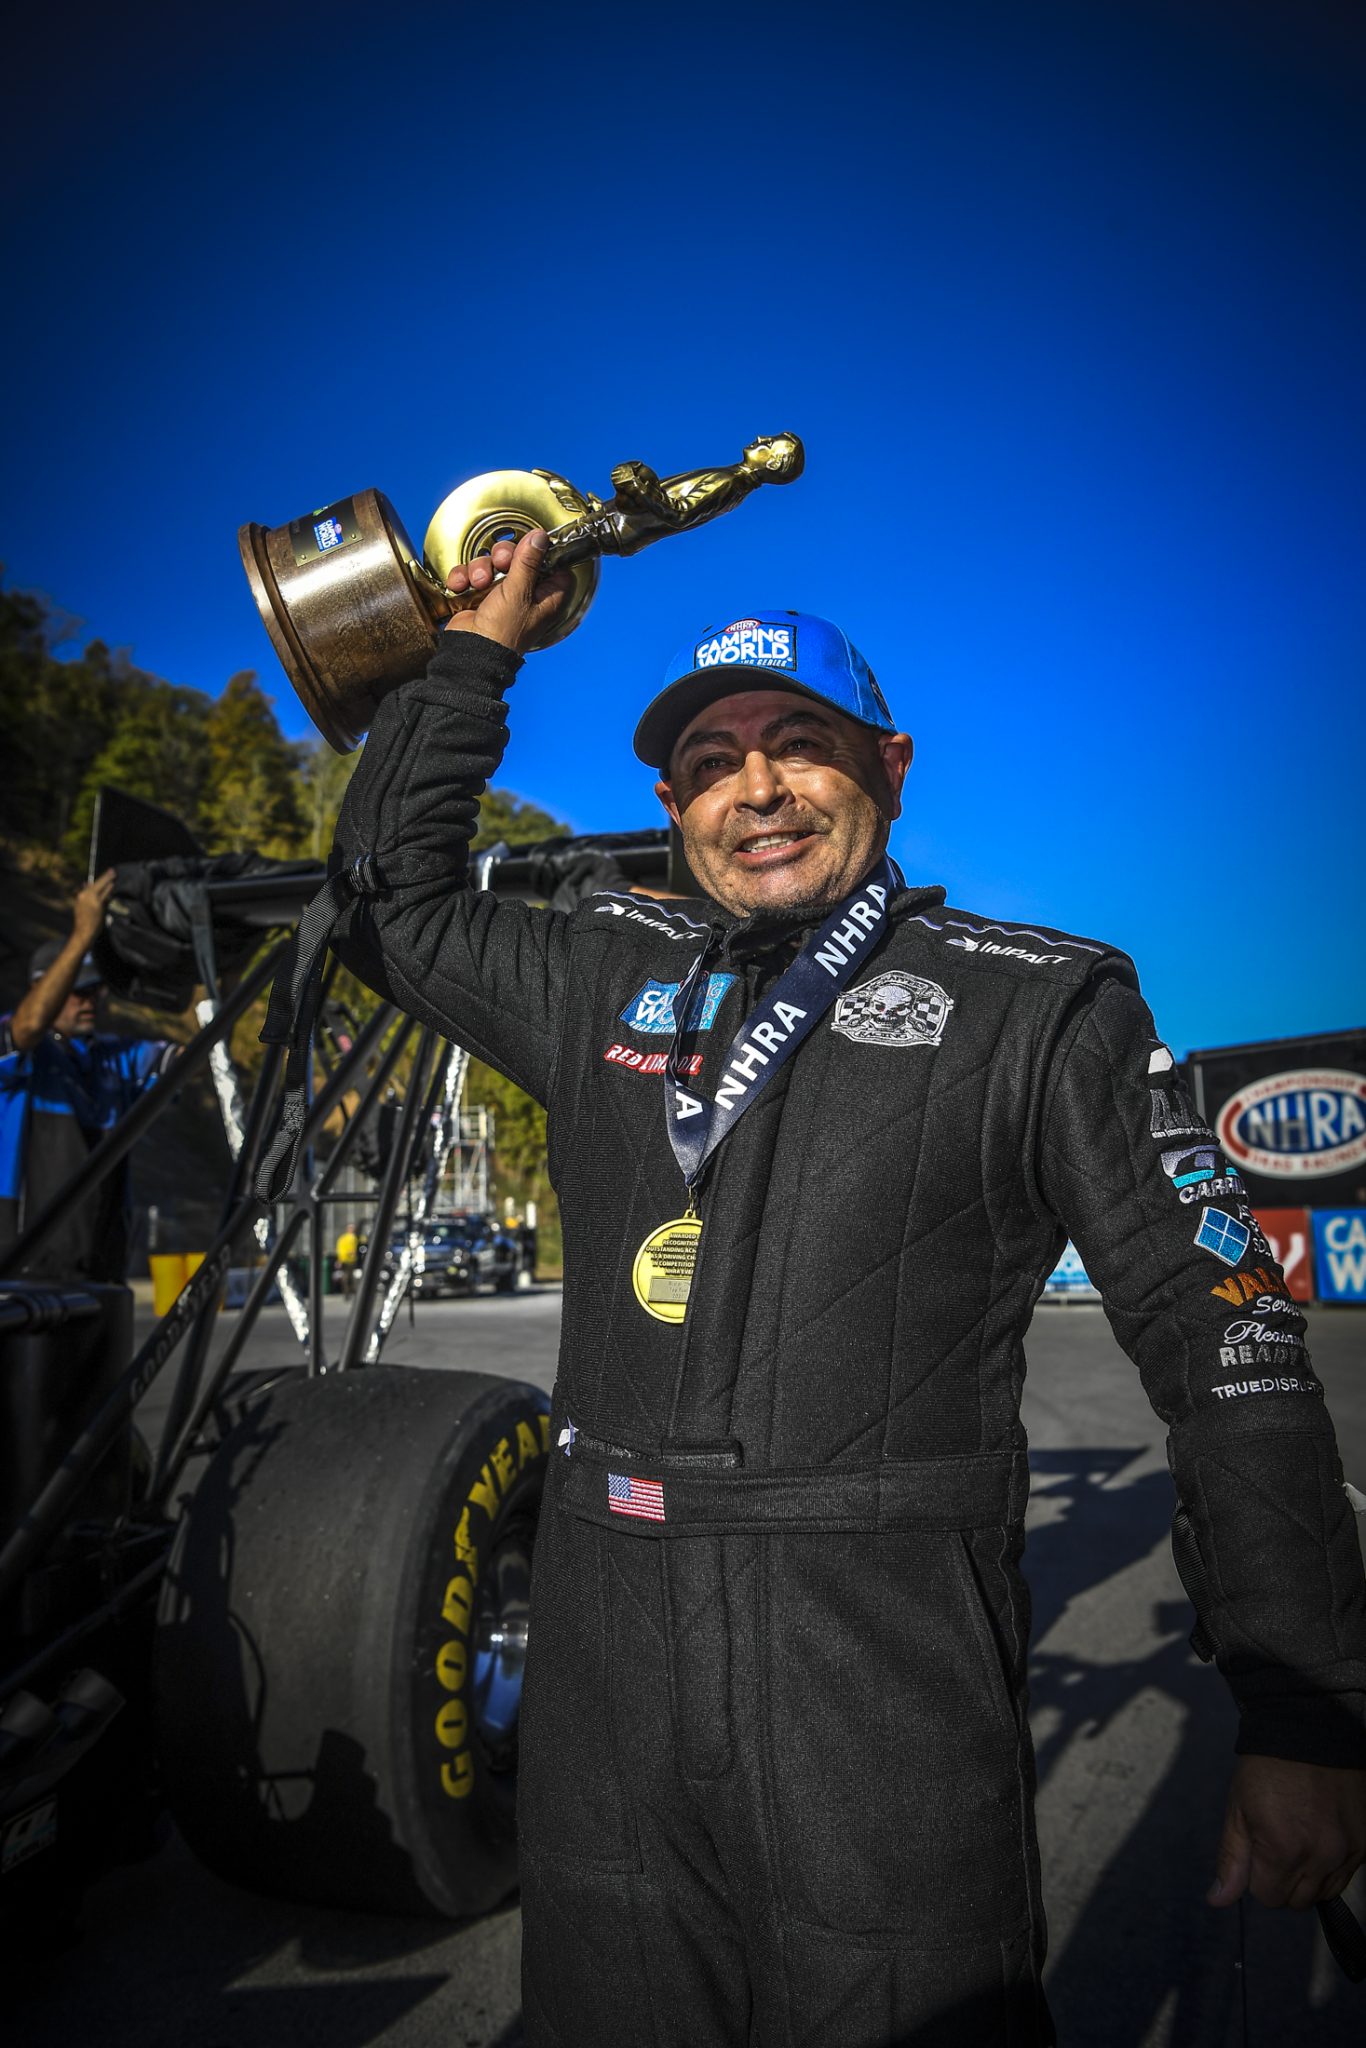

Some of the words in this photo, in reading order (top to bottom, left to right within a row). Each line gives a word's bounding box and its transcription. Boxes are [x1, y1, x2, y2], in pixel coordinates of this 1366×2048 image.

[697, 628, 790, 659] CAMPING
[698, 642, 790, 668] WORLD
[814, 883, 888, 978] NHRA
[979, 941, 1072, 965] IMPACT
[607, 1045, 643, 1067] RED
[714, 1000, 808, 1111] NHRA
[1248, 1091, 1366, 1152] NHRA
